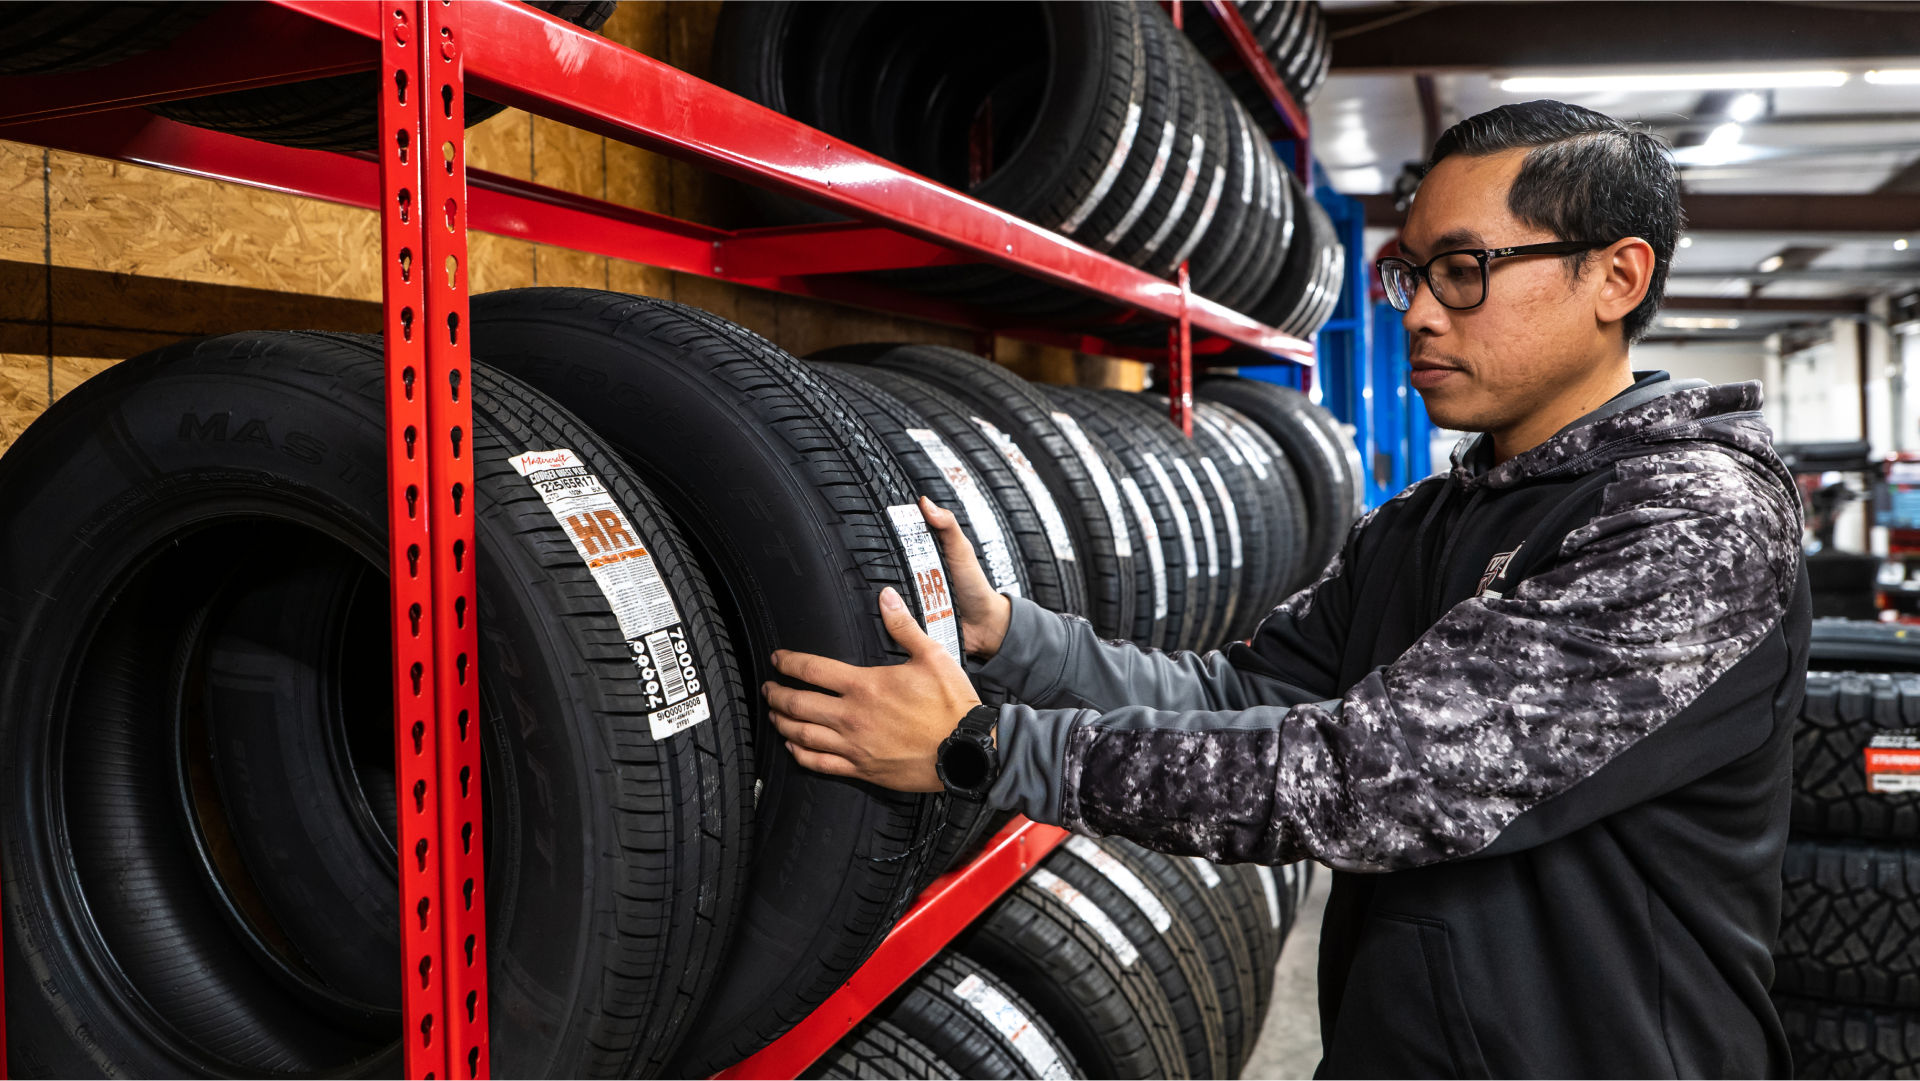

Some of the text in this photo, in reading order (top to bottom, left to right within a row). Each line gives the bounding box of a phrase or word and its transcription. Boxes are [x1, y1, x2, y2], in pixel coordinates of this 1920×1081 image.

[520, 453, 573, 474] Mastercraft
[555, 468, 575, 478] QUEST
[572, 466, 588, 476] PLUS
[540, 475, 595, 493] 225/65R17
[566, 510, 634, 556] HR
[669, 627, 701, 694] 79008
